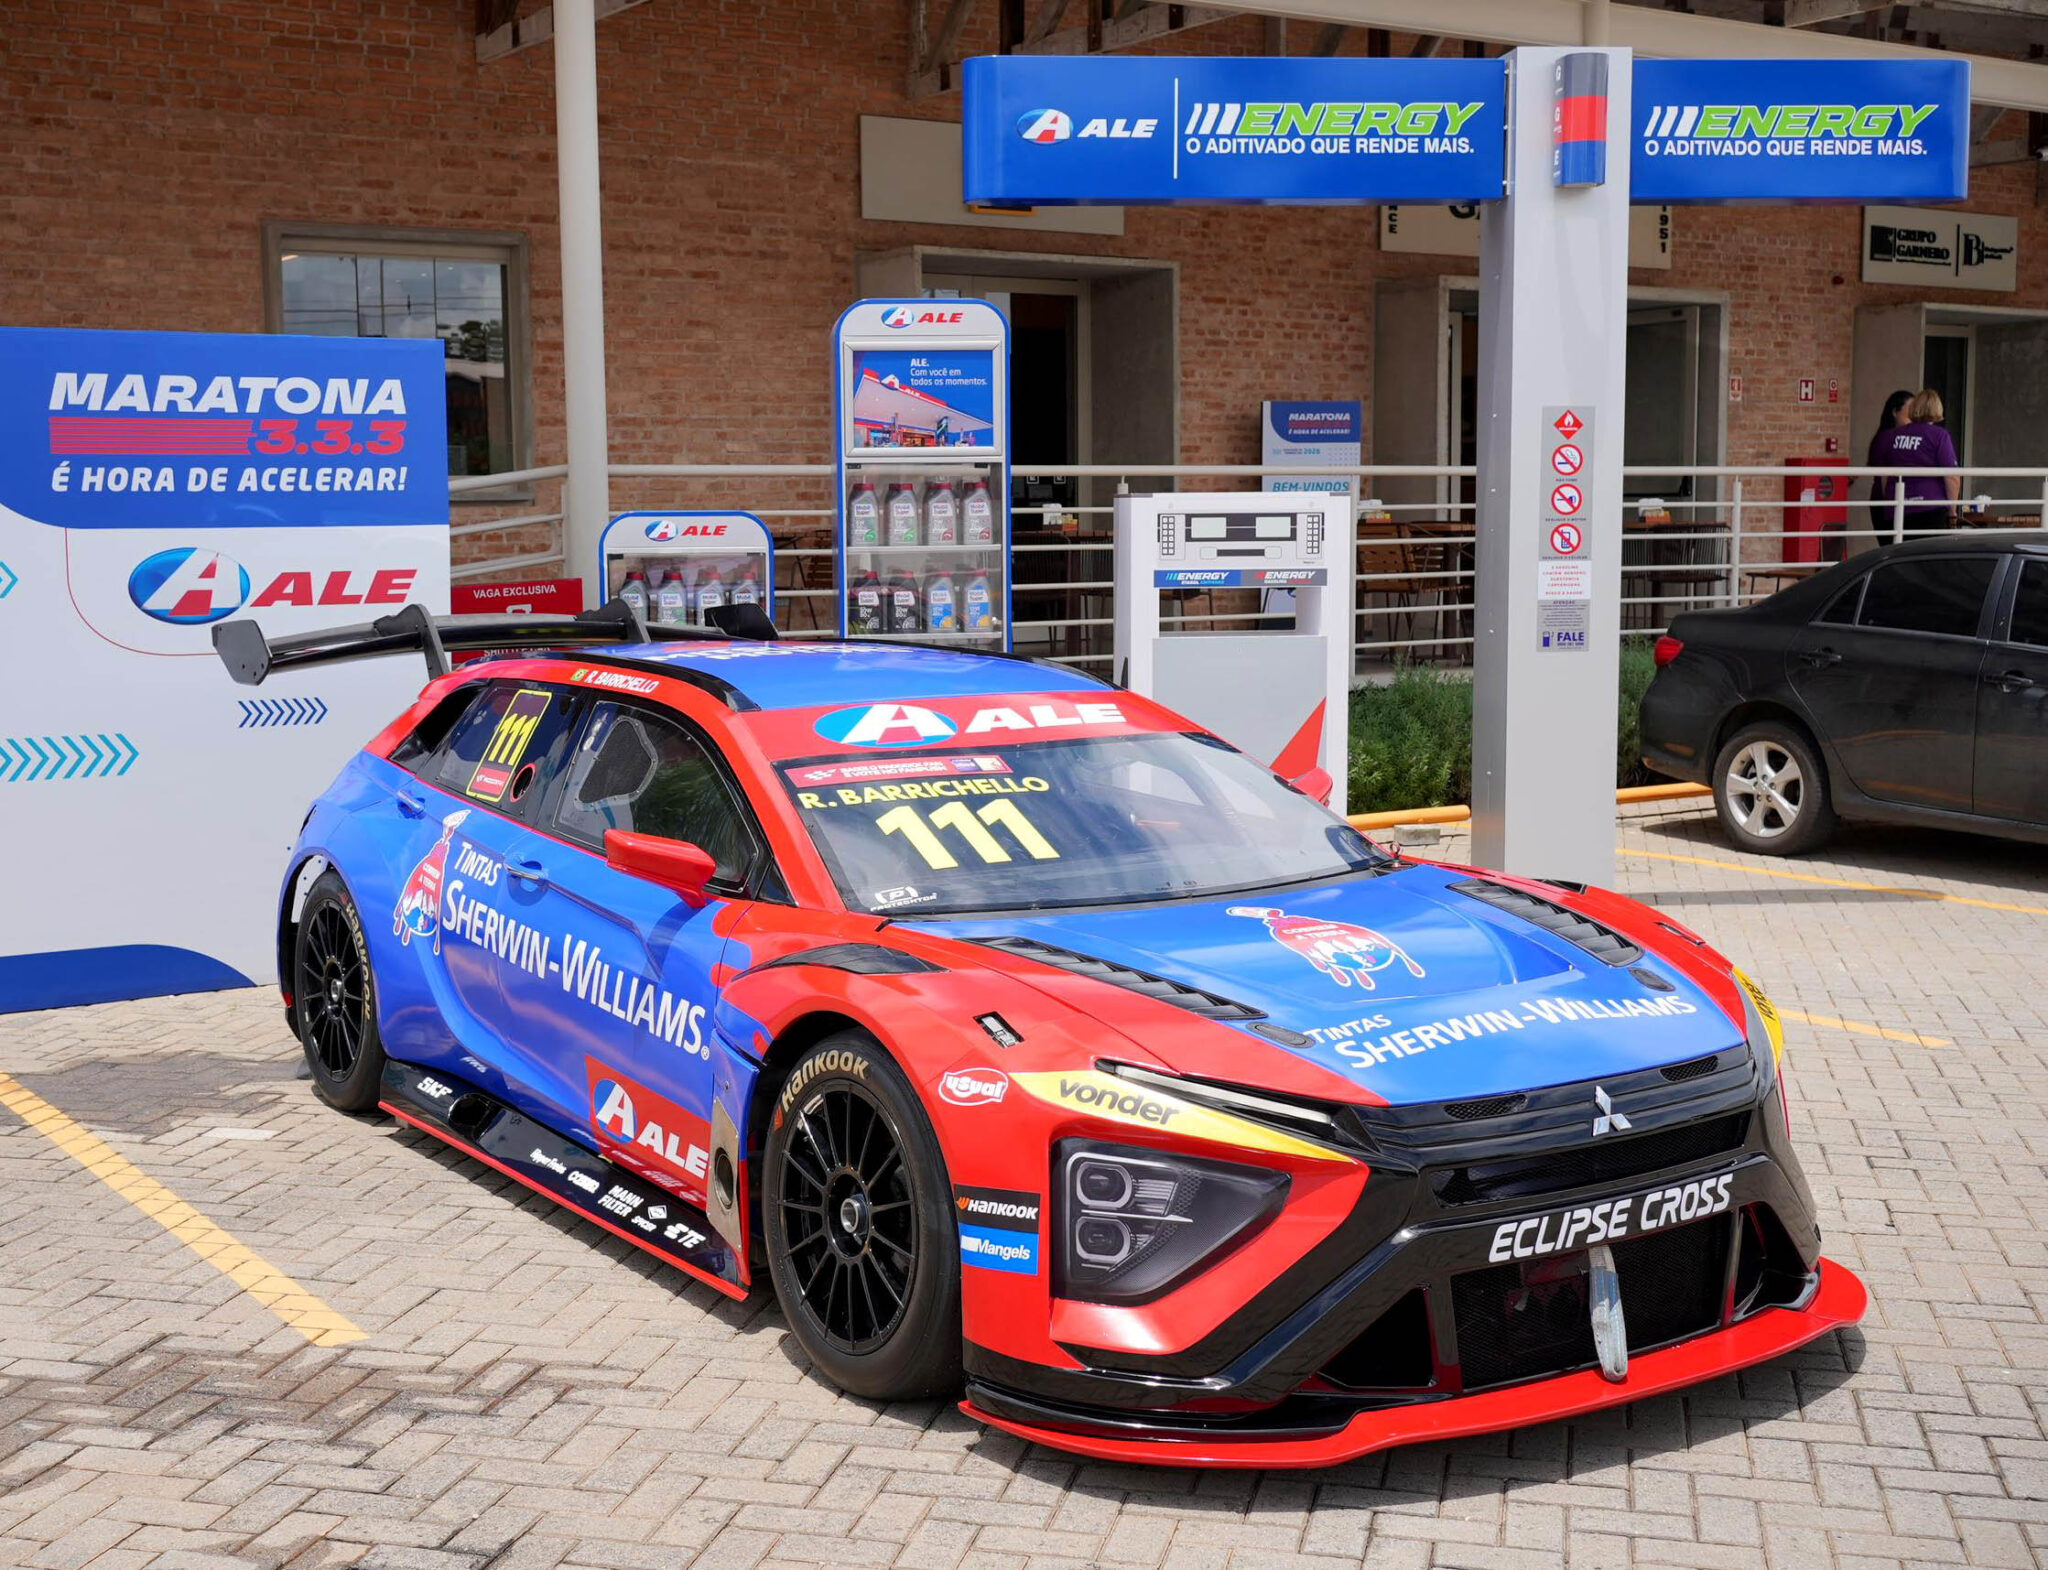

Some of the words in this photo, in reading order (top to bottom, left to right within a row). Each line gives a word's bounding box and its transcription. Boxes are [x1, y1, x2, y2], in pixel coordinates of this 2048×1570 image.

[1077, 118, 1158, 138] ALE
[1238, 102, 1484, 136] ENERGY
[1694, 104, 1938, 139] ENERGY
[1186, 138, 1201, 154] O
[1205, 138, 1306, 154] ADITIVADO
[1310, 138, 1351, 154] QUE
[1355, 138, 1419, 154] RENDE
[1424, 138, 1475, 154] MAIS.
[1645, 139, 1659, 156] O
[1664, 139, 1761, 156] ADITIVADO
[1766, 139, 1806, 156] QUE
[1811, 139, 1873, 156] RENDE
[1878, 139, 1928, 156] MAIS.
[1896, 229, 1936, 243] GRUPO
[918, 312, 964, 323] ALE
[910, 358, 929, 367] ALE.
[910, 368, 928, 376] Com
[929, 367, 947, 376] você
[910, 377, 933, 386] todos
[945, 378, 988, 386] momentos.
[49, 373, 407, 414] MARATONA
[1288, 412, 1351, 421] MARATONA
[254, 419, 407, 456] 3.3.3
[1892, 435, 1922, 450] STAFF
[51, 461, 71, 492] É
[82, 467, 175, 492] HORA
[187, 467, 229, 493] DE
[237, 466, 408, 492] ACELERAR!
[1272, 481, 1350, 492] BEM-VINDOS
[681, 525, 728, 536] ALE
[1177, 571, 1229, 581] ENERGY
[1264, 570, 1315, 580] ENERGY
[249, 568, 418, 608] ALE
[473, 588, 501, 599] VAGA
[502, 584, 557, 597] EXCLUSIVA
[1557, 632, 1584, 642] FALE
[593, 671, 660, 693] BARRICHELLO
[965, 703, 1126, 734] ALE
[487, 713, 538, 767] 111
[797, 791, 837, 809] R.
[838, 775, 1050, 807] BARRICHELLO
[875, 798, 1060, 870] 111
[453, 841, 502, 887] TINTAS
[1304, 1013, 1392, 1044] TINTAS
[1335, 995, 1697, 1069] SHERWIN-WILLIAMS
[417, 1077, 453, 1098] SKF
[946, 1075, 1005, 1098] usual
[1060, 1079, 1180, 1125] vonder
[636, 1121, 709, 1180] ALE
[598, 1195, 633, 1218] FILTER
[608, 1185, 644, 1208] MANN
[1489, 1198, 1632, 1263] ECLIPSE
[1640, 1173, 1734, 1231] CROSS
[978, 1238, 1031, 1260] Mangels
